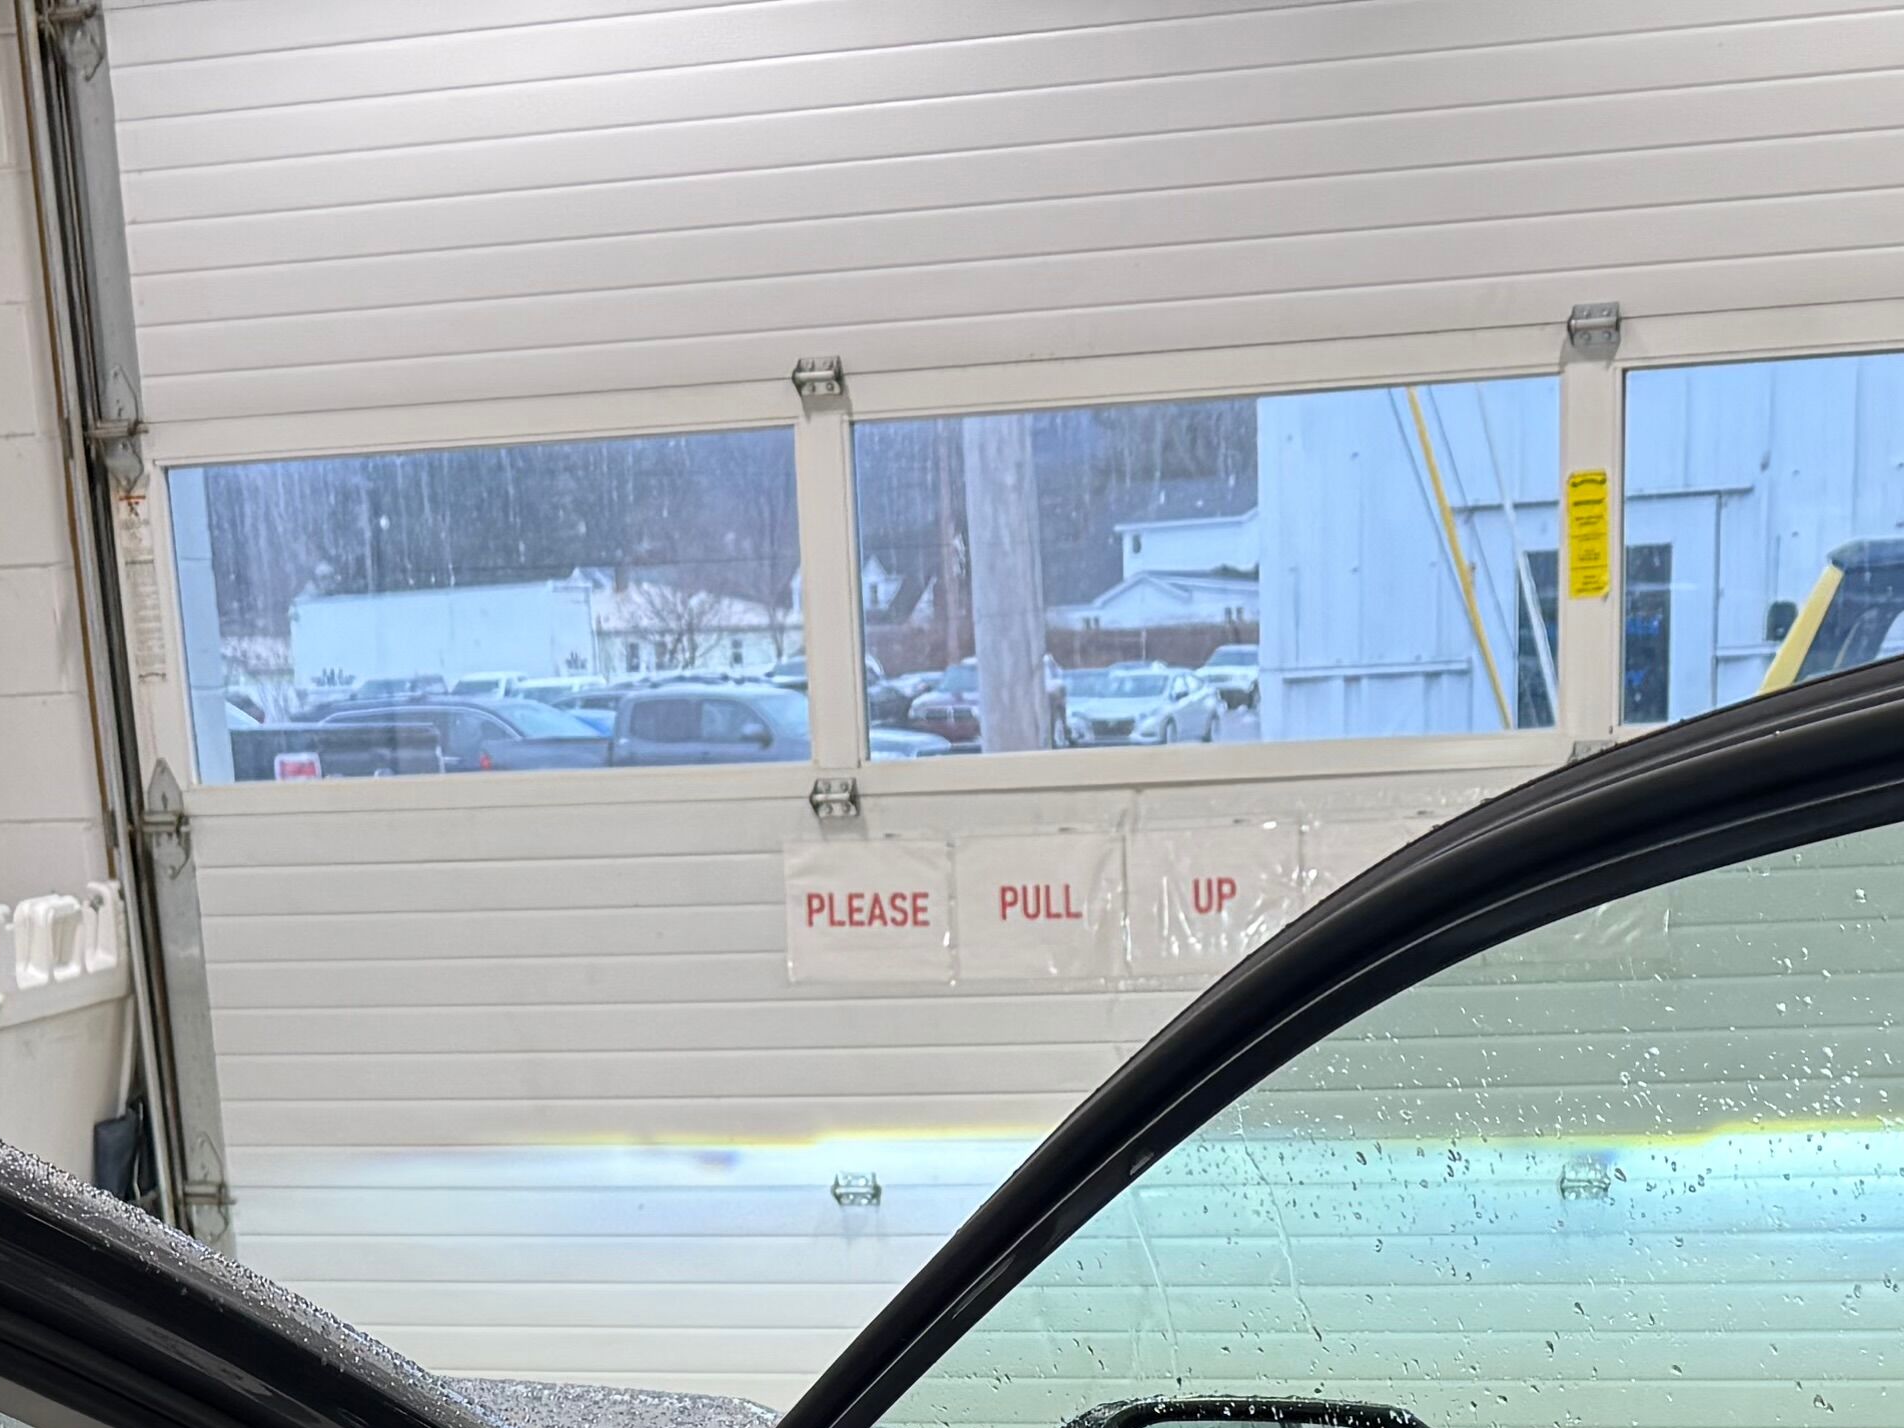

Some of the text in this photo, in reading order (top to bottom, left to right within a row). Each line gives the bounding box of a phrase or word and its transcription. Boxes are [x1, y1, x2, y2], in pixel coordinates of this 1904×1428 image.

[806, 877, 1237, 928] PLEASE PULL UP
